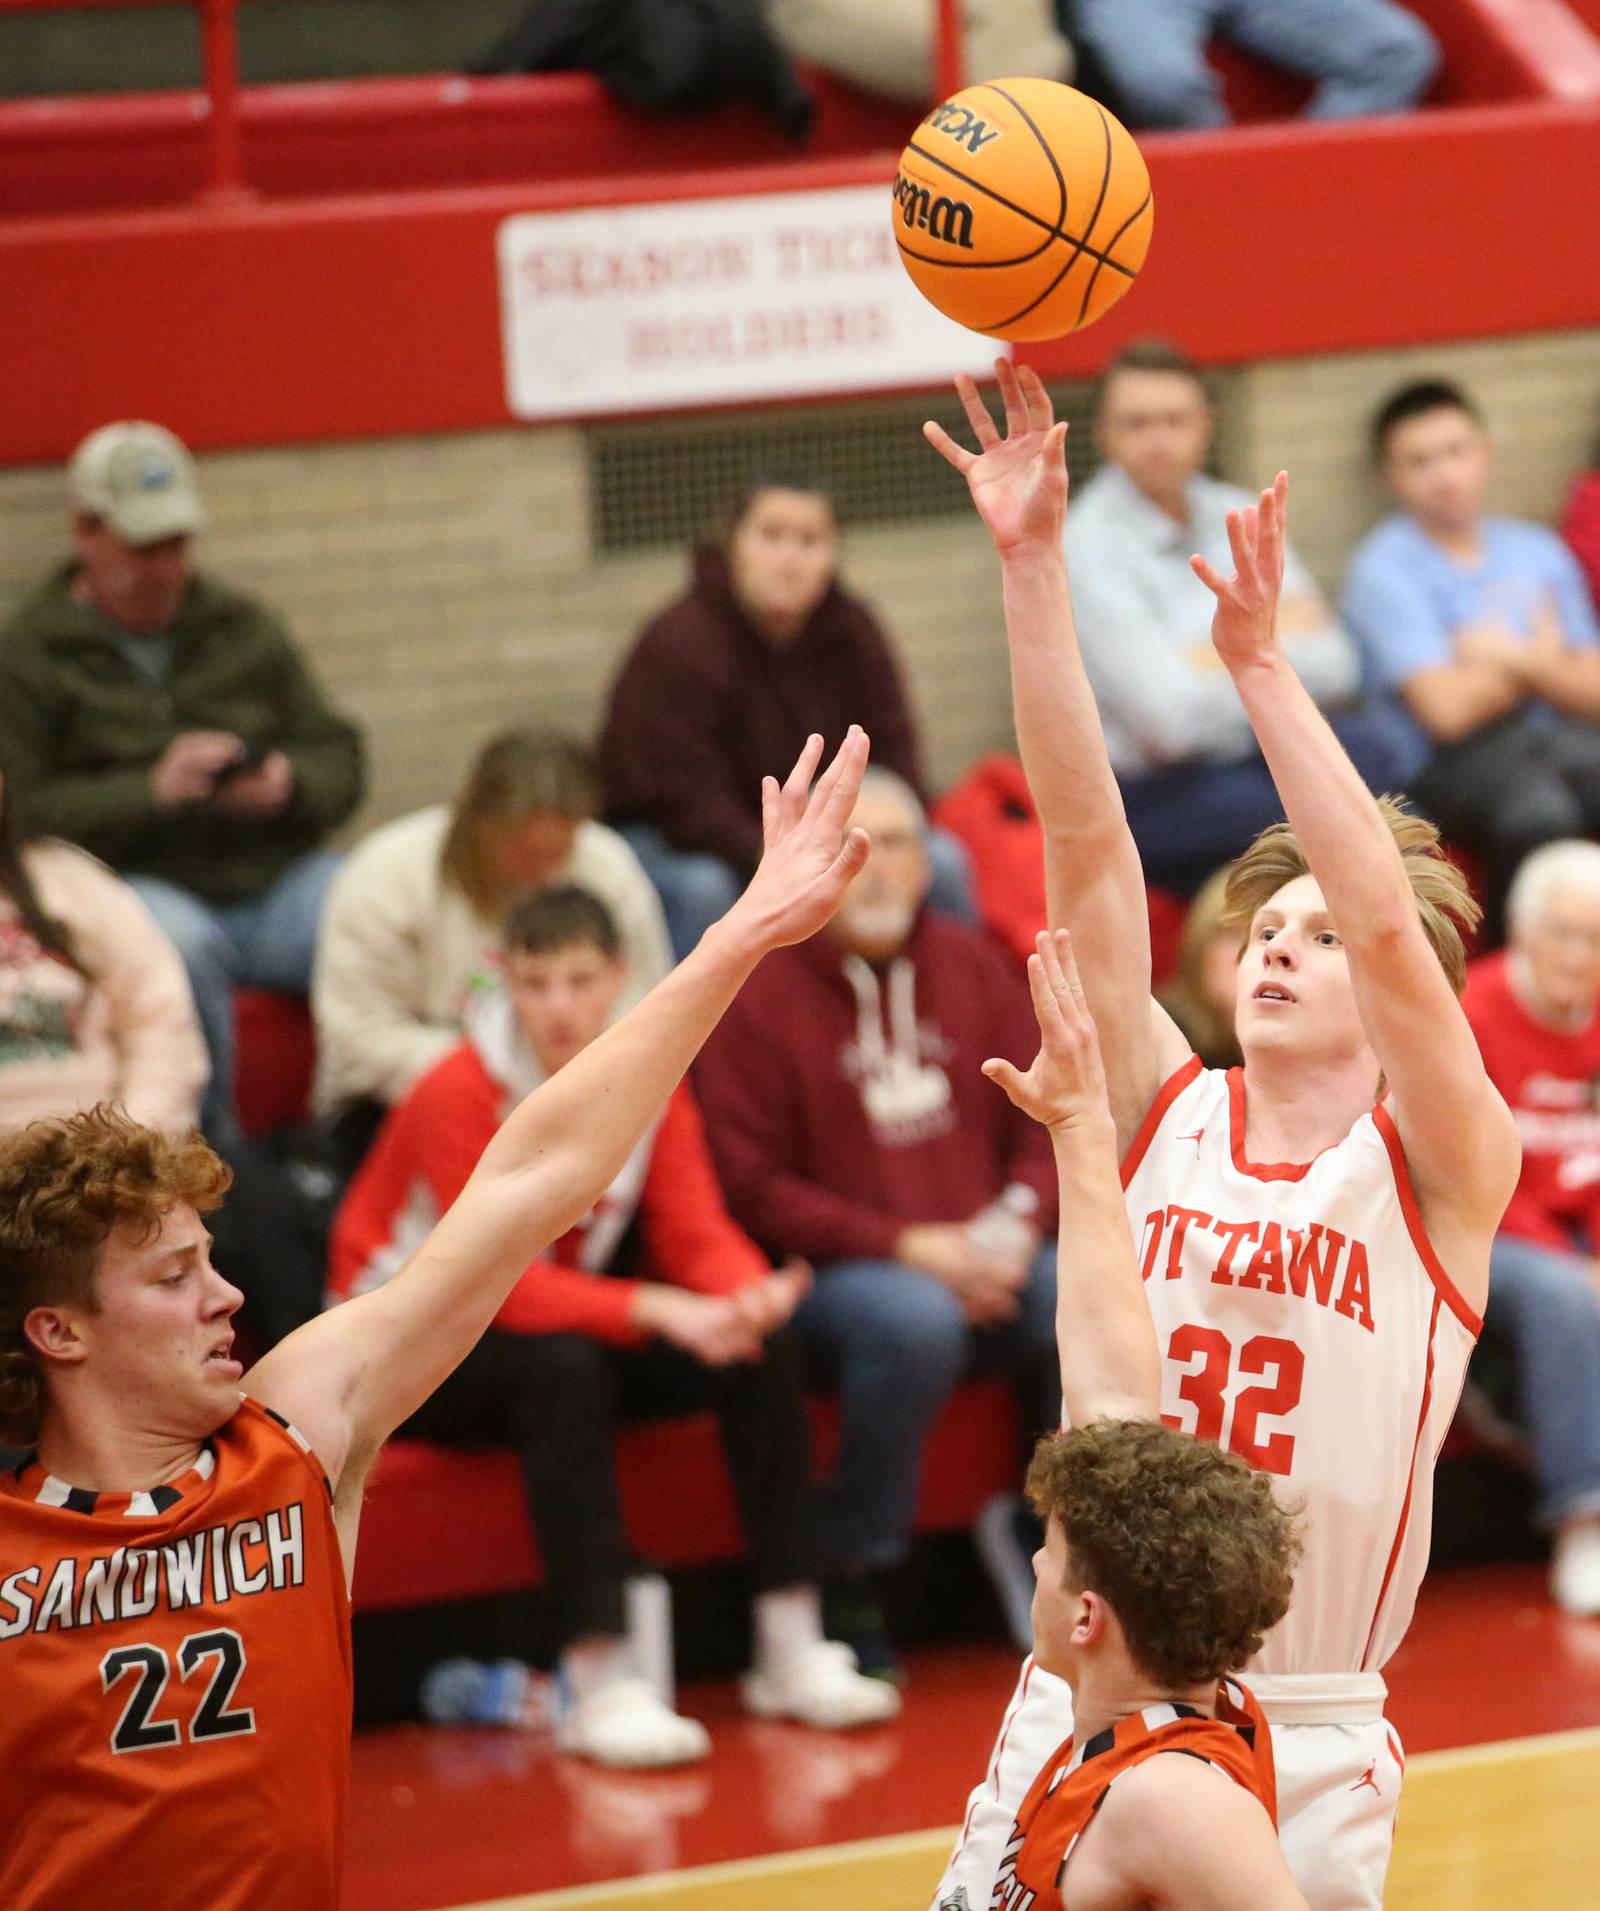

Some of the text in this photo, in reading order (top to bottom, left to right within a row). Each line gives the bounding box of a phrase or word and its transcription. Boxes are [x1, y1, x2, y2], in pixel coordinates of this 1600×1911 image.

[1160, 1323, 1305, 1476] 32
[0, 1501, 304, 1640] SANDWICH
[100, 1627, 256, 1755] 22
